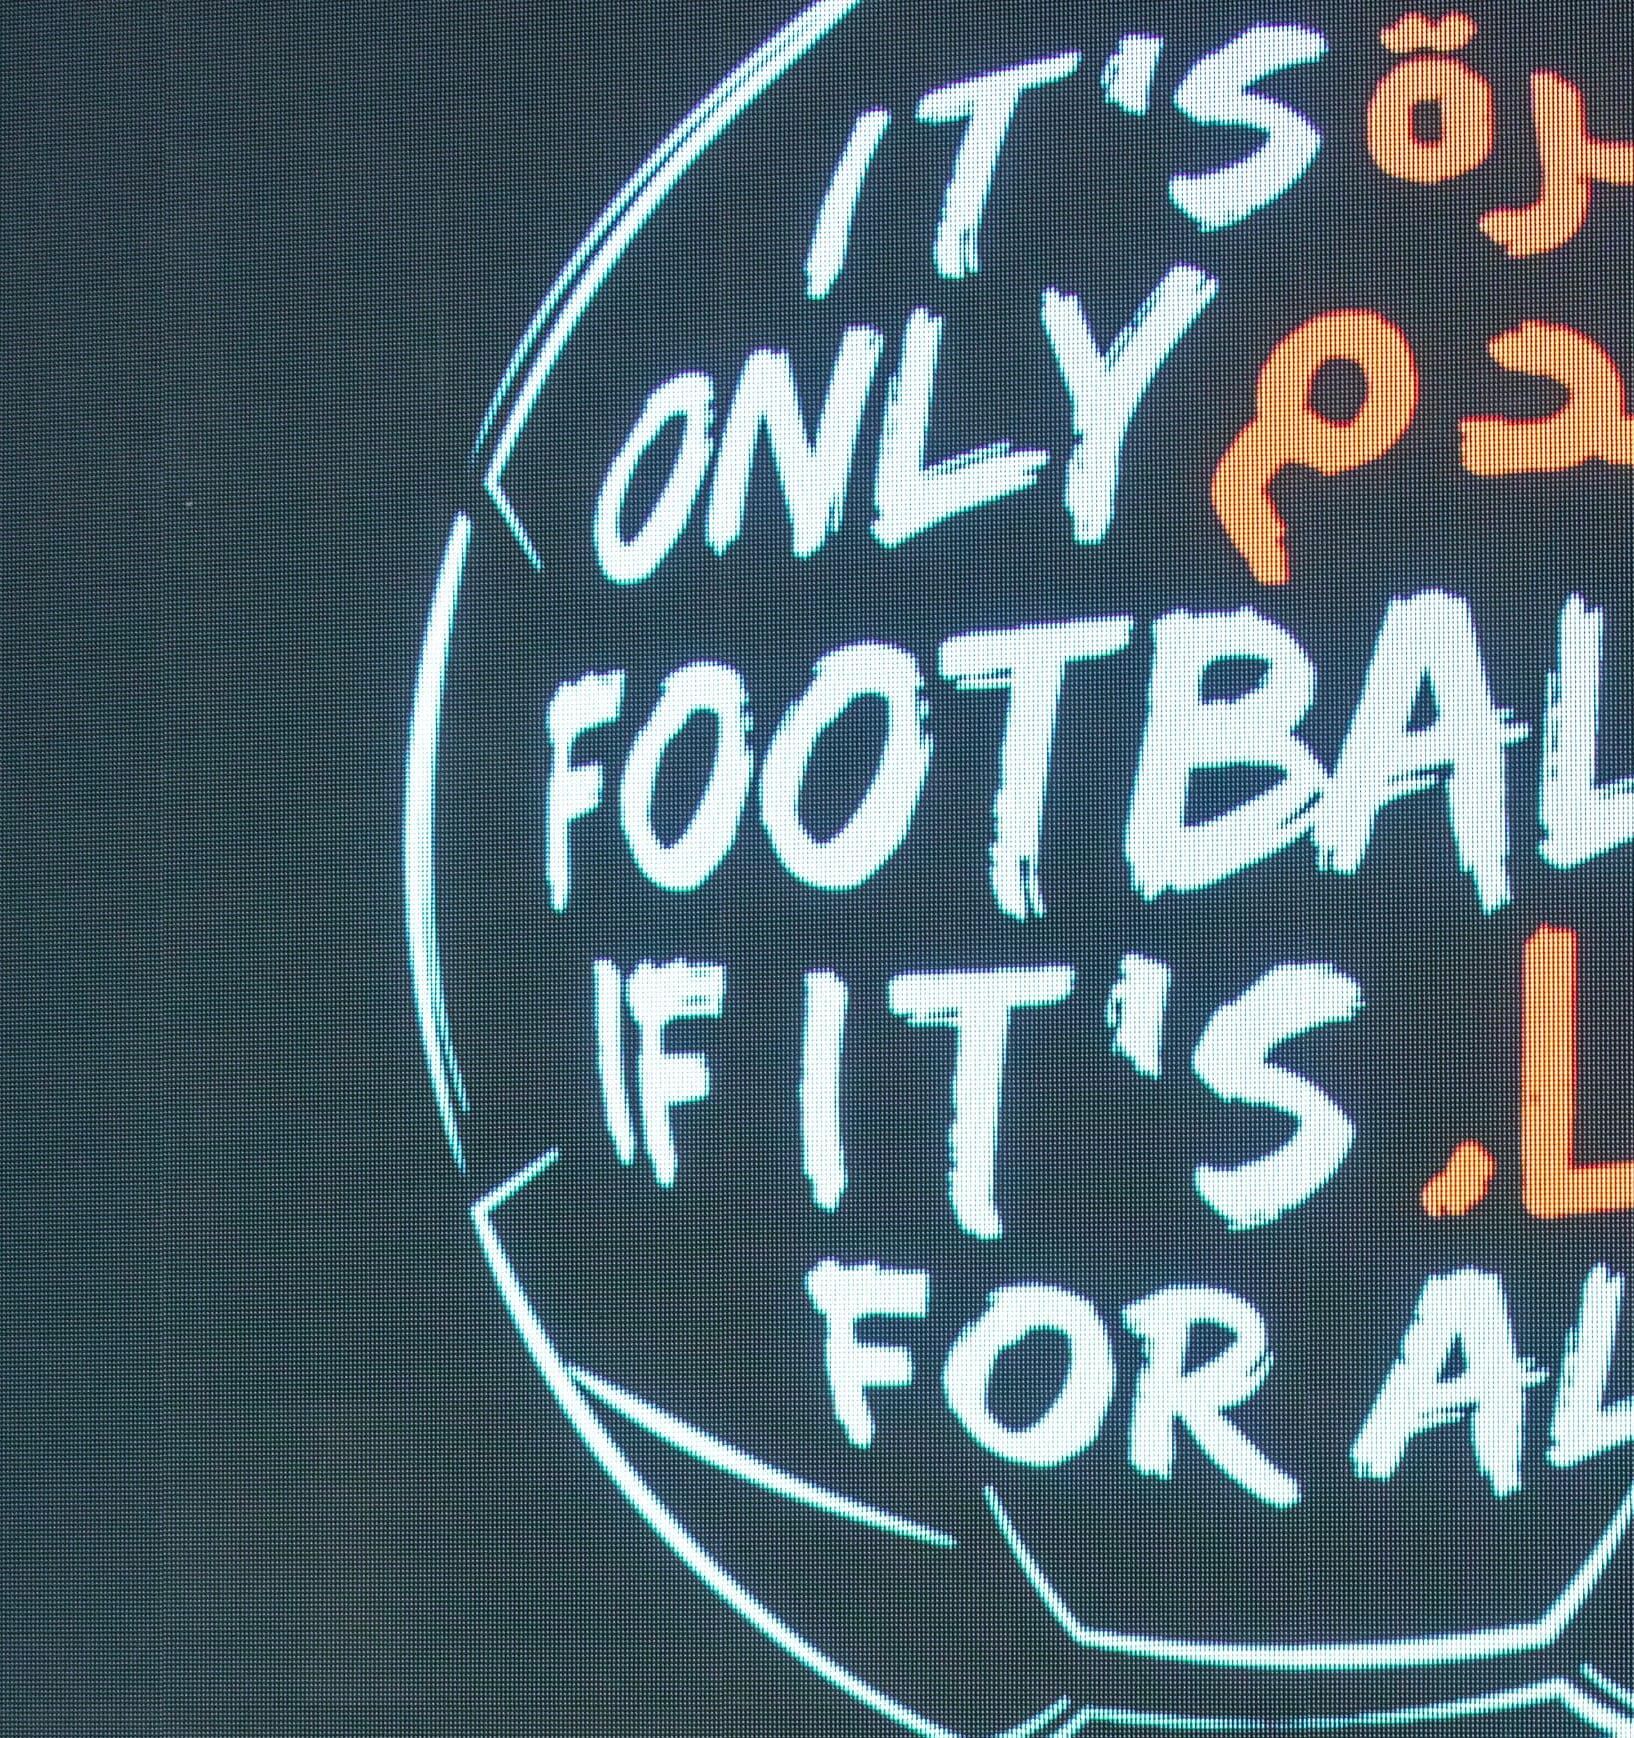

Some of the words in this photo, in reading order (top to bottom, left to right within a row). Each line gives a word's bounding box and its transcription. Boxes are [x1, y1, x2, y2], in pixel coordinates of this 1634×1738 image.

[804, 25, 1327, 300] IT'S
[592, 265, 1219, 586] ONLY
[592, 958, 728, 1188] IF
[797, 953, 1363, 1241] IT'S
[804, 1258, 1301, 1509] FOR
